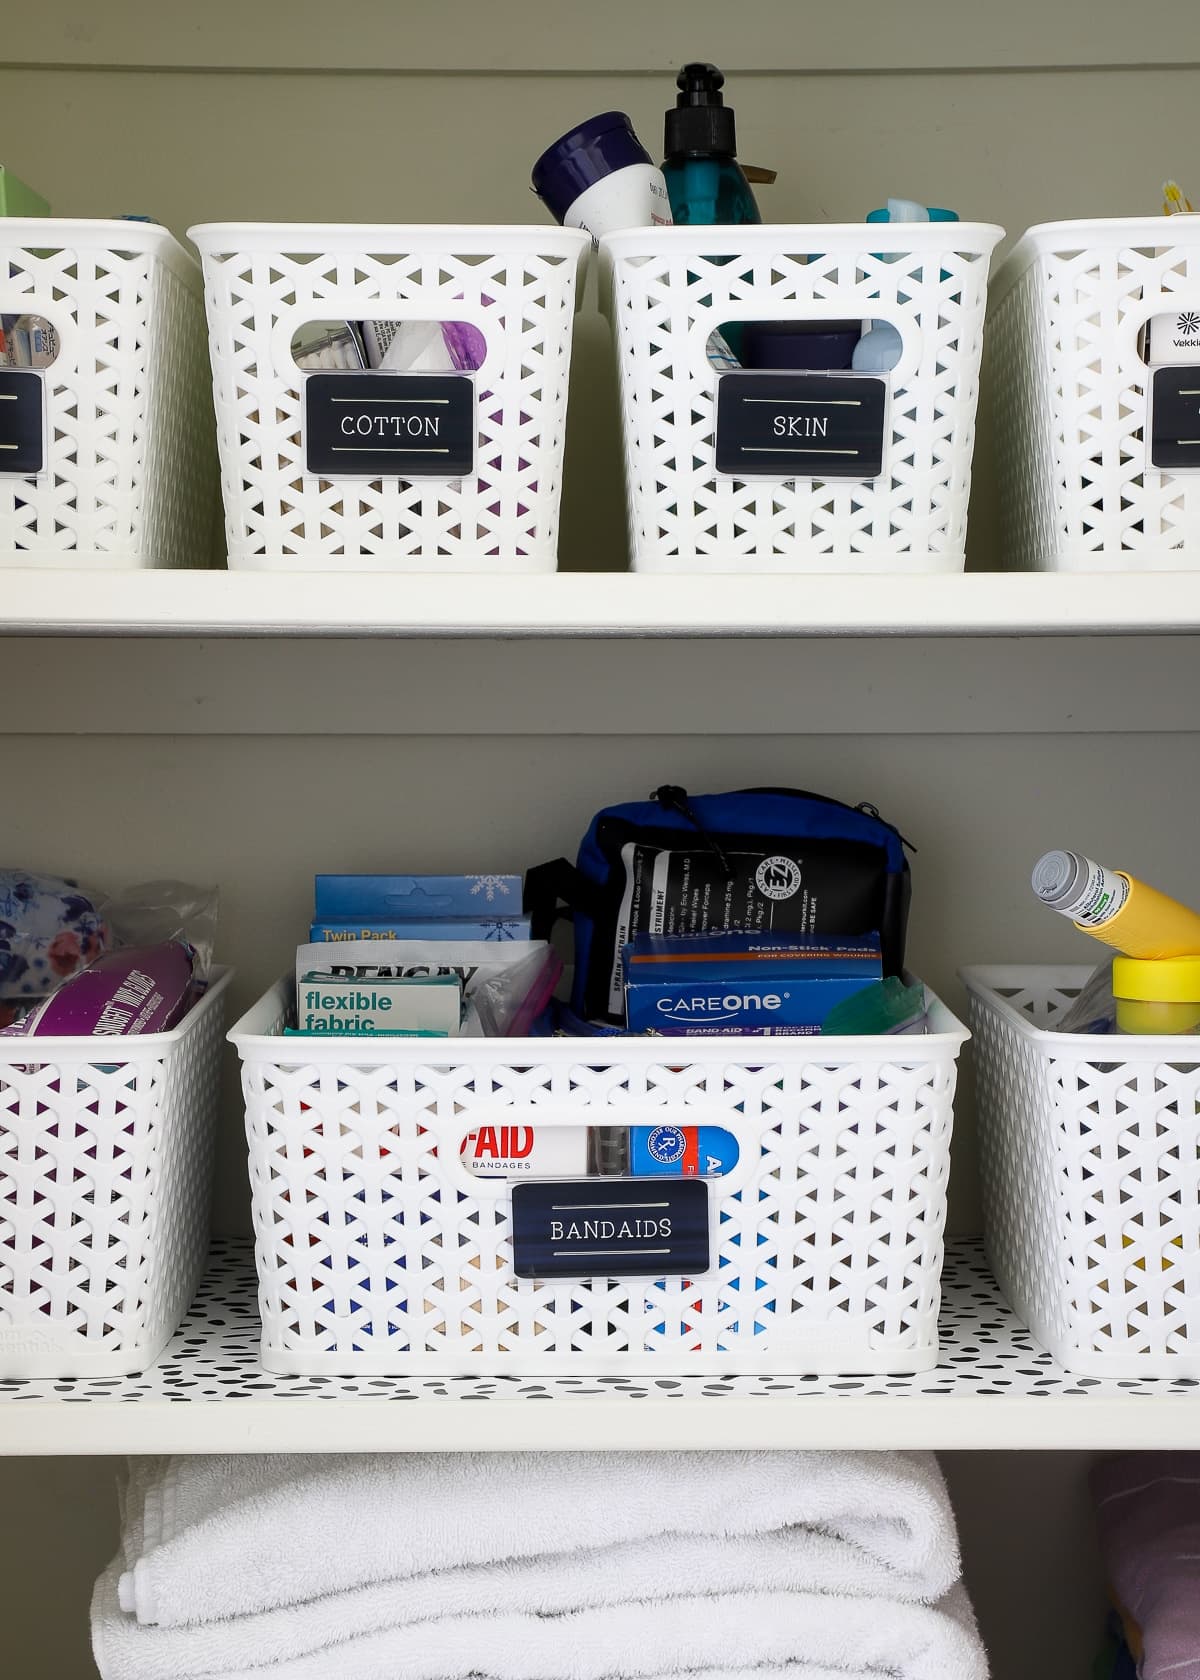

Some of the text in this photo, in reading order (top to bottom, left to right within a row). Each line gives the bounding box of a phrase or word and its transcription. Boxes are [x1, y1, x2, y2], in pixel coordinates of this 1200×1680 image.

[340, 416, 441, 437] COTTON
[773, 416, 828, 438] SKIN
[769, 866, 788, 892] EZ
[692, 888, 700, 909] Wipes
[702, 883, 712, 910] Forceps
[724, 892, 732, 902] 25
[810, 914, 816, 923] BE
[323, 930, 398, 942] Twin Pack
[614, 964, 622, 992] SPRAIN
[305, 992, 392, 1010] flexible
[305, 1014, 375, 1031] fabric
[550, 1218, 672, 1240] BANDAIDS
